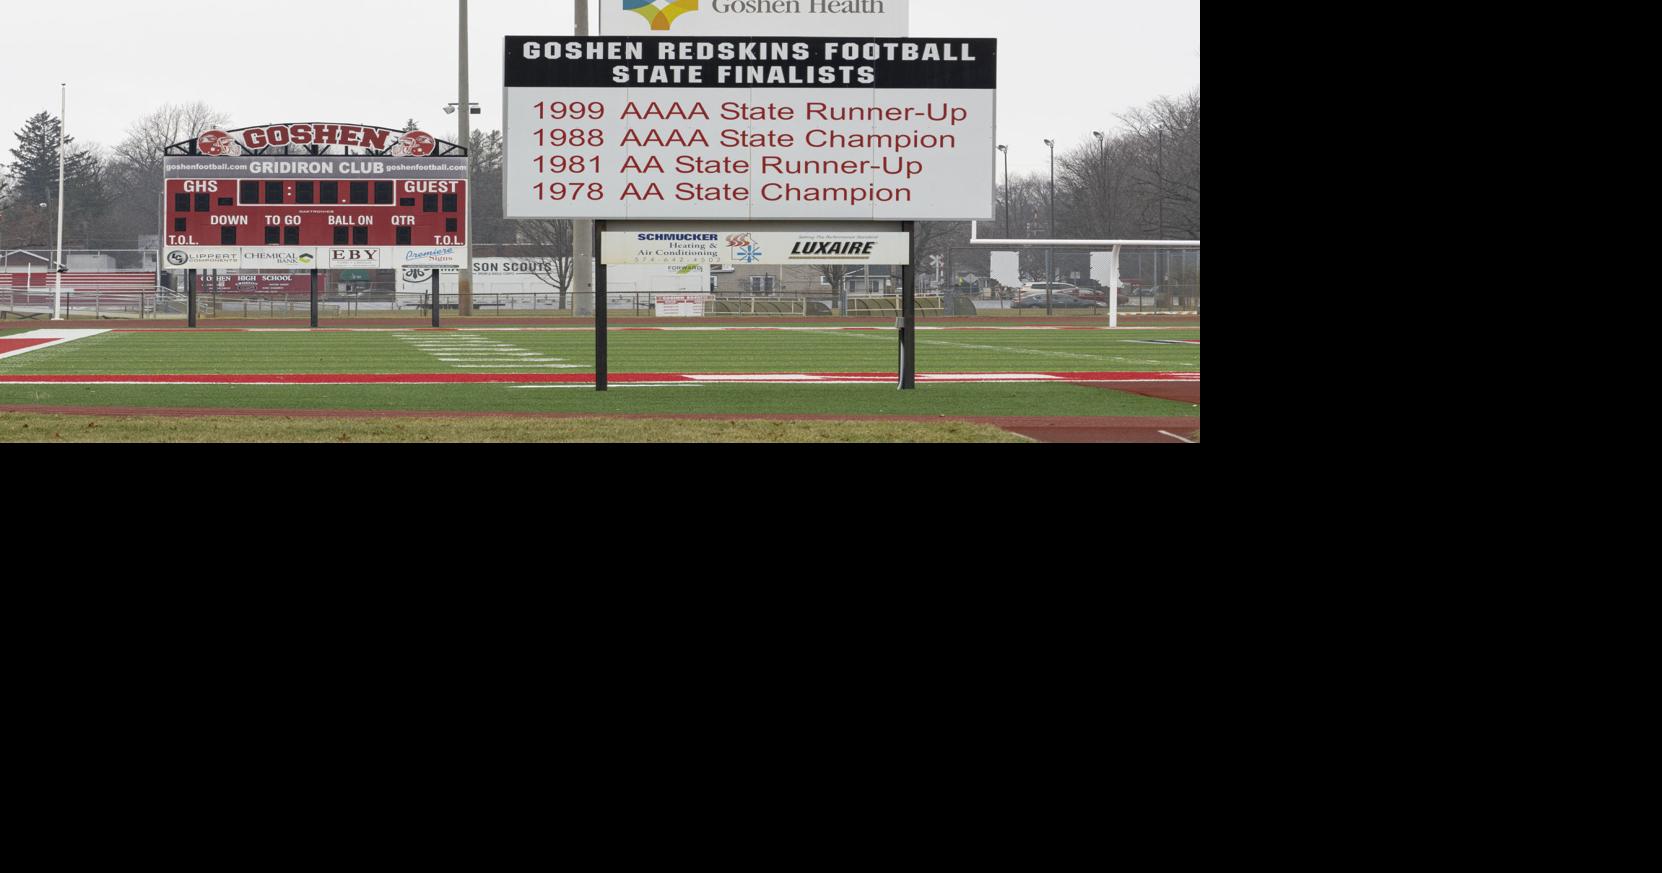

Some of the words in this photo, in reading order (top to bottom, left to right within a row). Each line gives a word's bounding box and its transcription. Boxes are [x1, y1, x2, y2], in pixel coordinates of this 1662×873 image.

[711, 0, 800, 14] Goshen
[808, 0, 886, 14] Health
[522, 41, 643, 60] GOSHEN
[658, 41, 810, 61] REDSKINS
[824, 42, 977, 61] FOOTBALL
[612, 65, 703, 84] STATE
[717, 65, 875, 84] FINALISTS
[532, 101, 605, 120] 1999
[620, 102, 710, 120] AAAA
[720, 102, 795, 121] State
[806, 102, 968, 126] Runner-Up
[242, 124, 390, 150] GOSHEN
[532, 128, 604, 147] 1988
[620, 129, 710, 147] AAAA
[720, 129, 795, 148] State
[805, 129, 956, 153] Champion
[165, 163, 247, 171] goshenfootball.com
[249, 161, 334, 174] GRIDIRON
[338, 161, 384, 174] CLUB
[386, 164, 467, 172] goshenfootball.com
[532, 155, 600, 174] 1981
[620, 155, 665, 174] AA
[674, 155, 750, 174] State
[761, 156, 924, 179] Runner-Up
[183, 180, 218, 193] GHS
[404, 180, 459, 193] GUEST
[532, 182, 604, 201] 1978
[620, 182, 665, 201] AA
[674, 182, 750, 201] State
[760, 183, 912, 206] Champion
[210, 215, 248, 225] DOWN
[264, 215, 281, 225] TO
[284, 215, 302, 225] GO
[328, 215, 355, 225] BALL
[357, 215, 373, 225] ON
[391, 215, 416, 226] QTR
[168, 235, 200, 245] T.O.L.
[433, 235, 464, 245] T.O.L.
[405, 246, 454, 260] Premiere
[655, 249, 719, 257] Conditioning
[790, 242, 875, 254] LUXAIRE
[332, 249, 378, 260] EBY
[503, 262, 553, 272] SCOUTS
